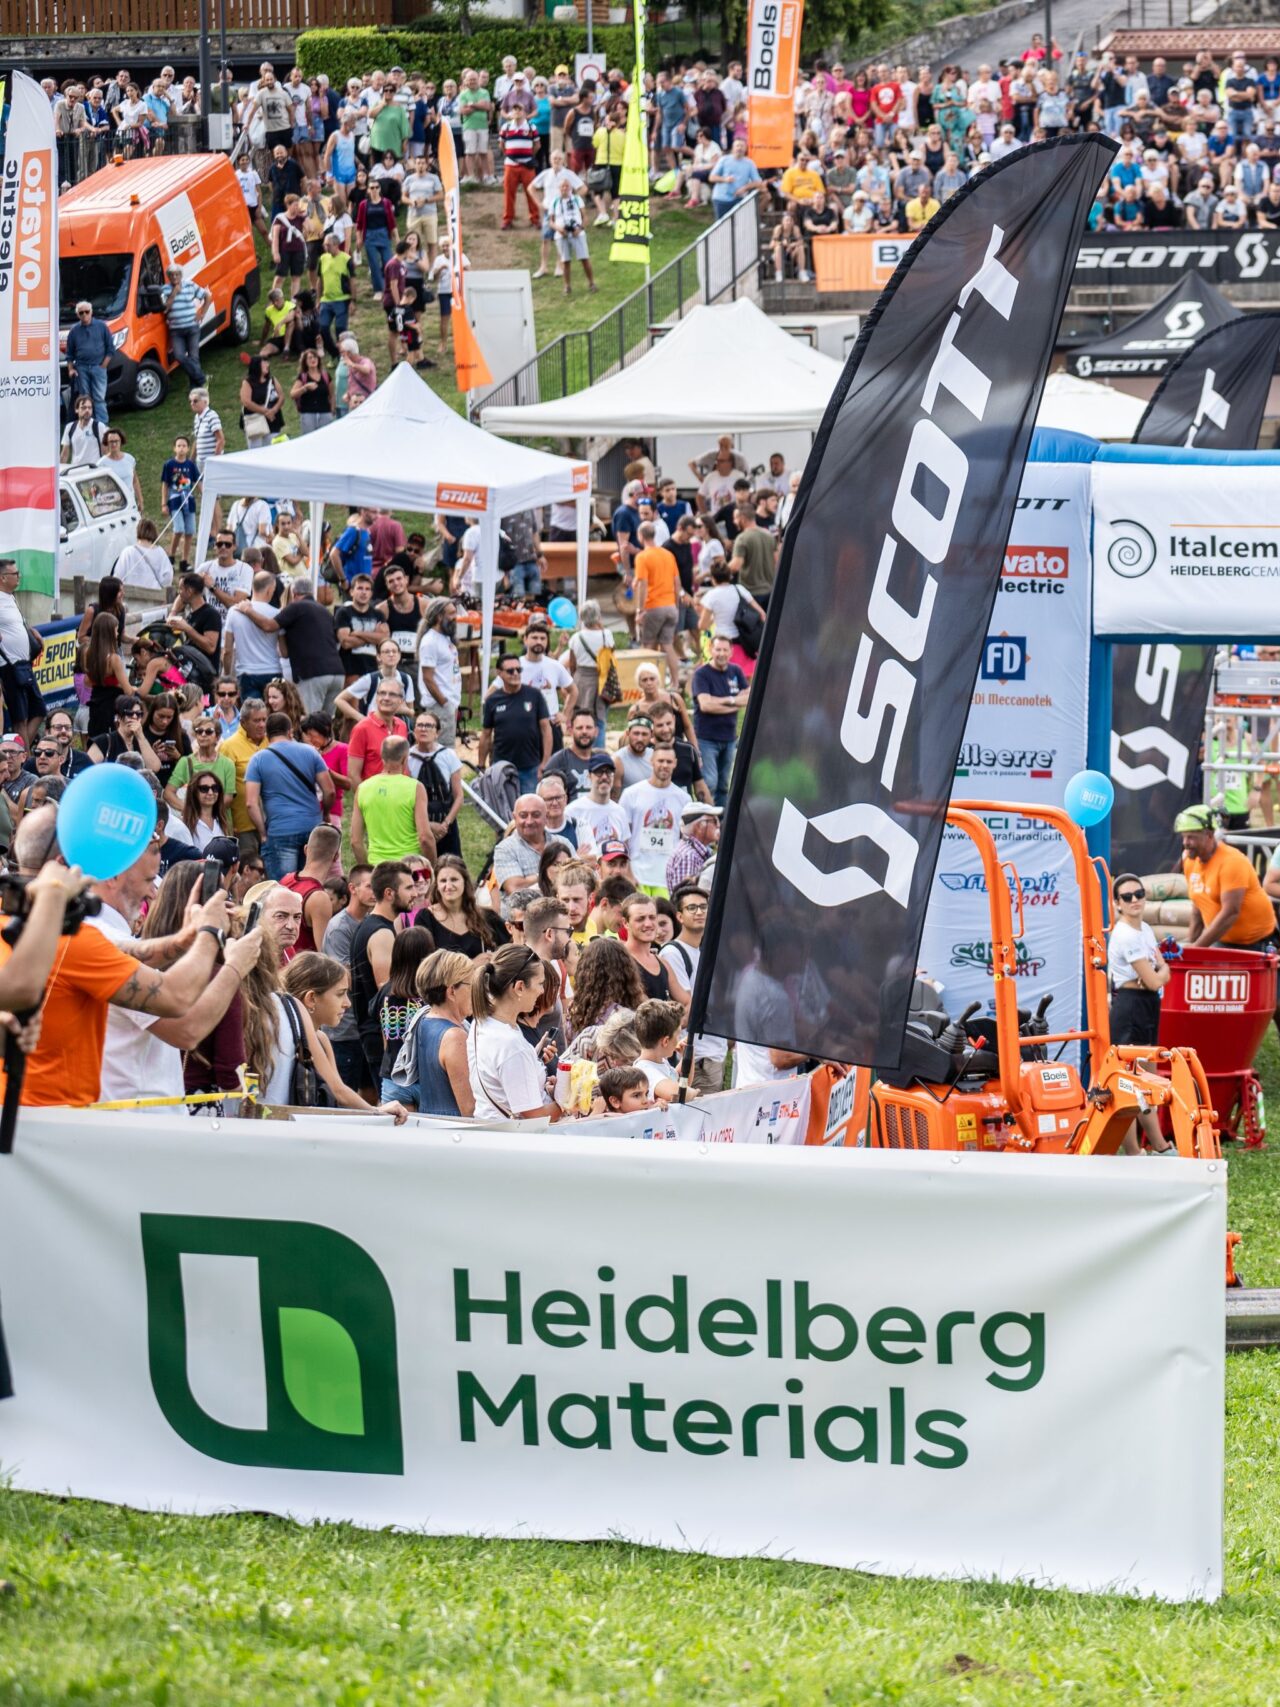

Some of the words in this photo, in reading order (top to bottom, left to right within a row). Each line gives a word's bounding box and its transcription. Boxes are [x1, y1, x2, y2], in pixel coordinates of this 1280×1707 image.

[754, 5, 777, 90] Boels
[170, 230, 196, 254] Boels
[1075, 247, 1230, 269] SCOTT
[1093, 359, 1168, 371] SCOTT
[440, 489, 483, 504] STIHL
[840, 224, 1019, 792] SCOTT
[988, 693, 1053, 708] Meccanotek
[1080, 790, 1108, 806] BUTTI
[98, 805, 145, 837] BUTTI
[650, 836, 665, 847] 94
[1190, 974, 1246, 1000] BUTTI
[1042, 1070, 1068, 1082] Boels
[453, 1265, 1046, 1392] Heidelberg
[458, 1370, 970, 1470] Materials
